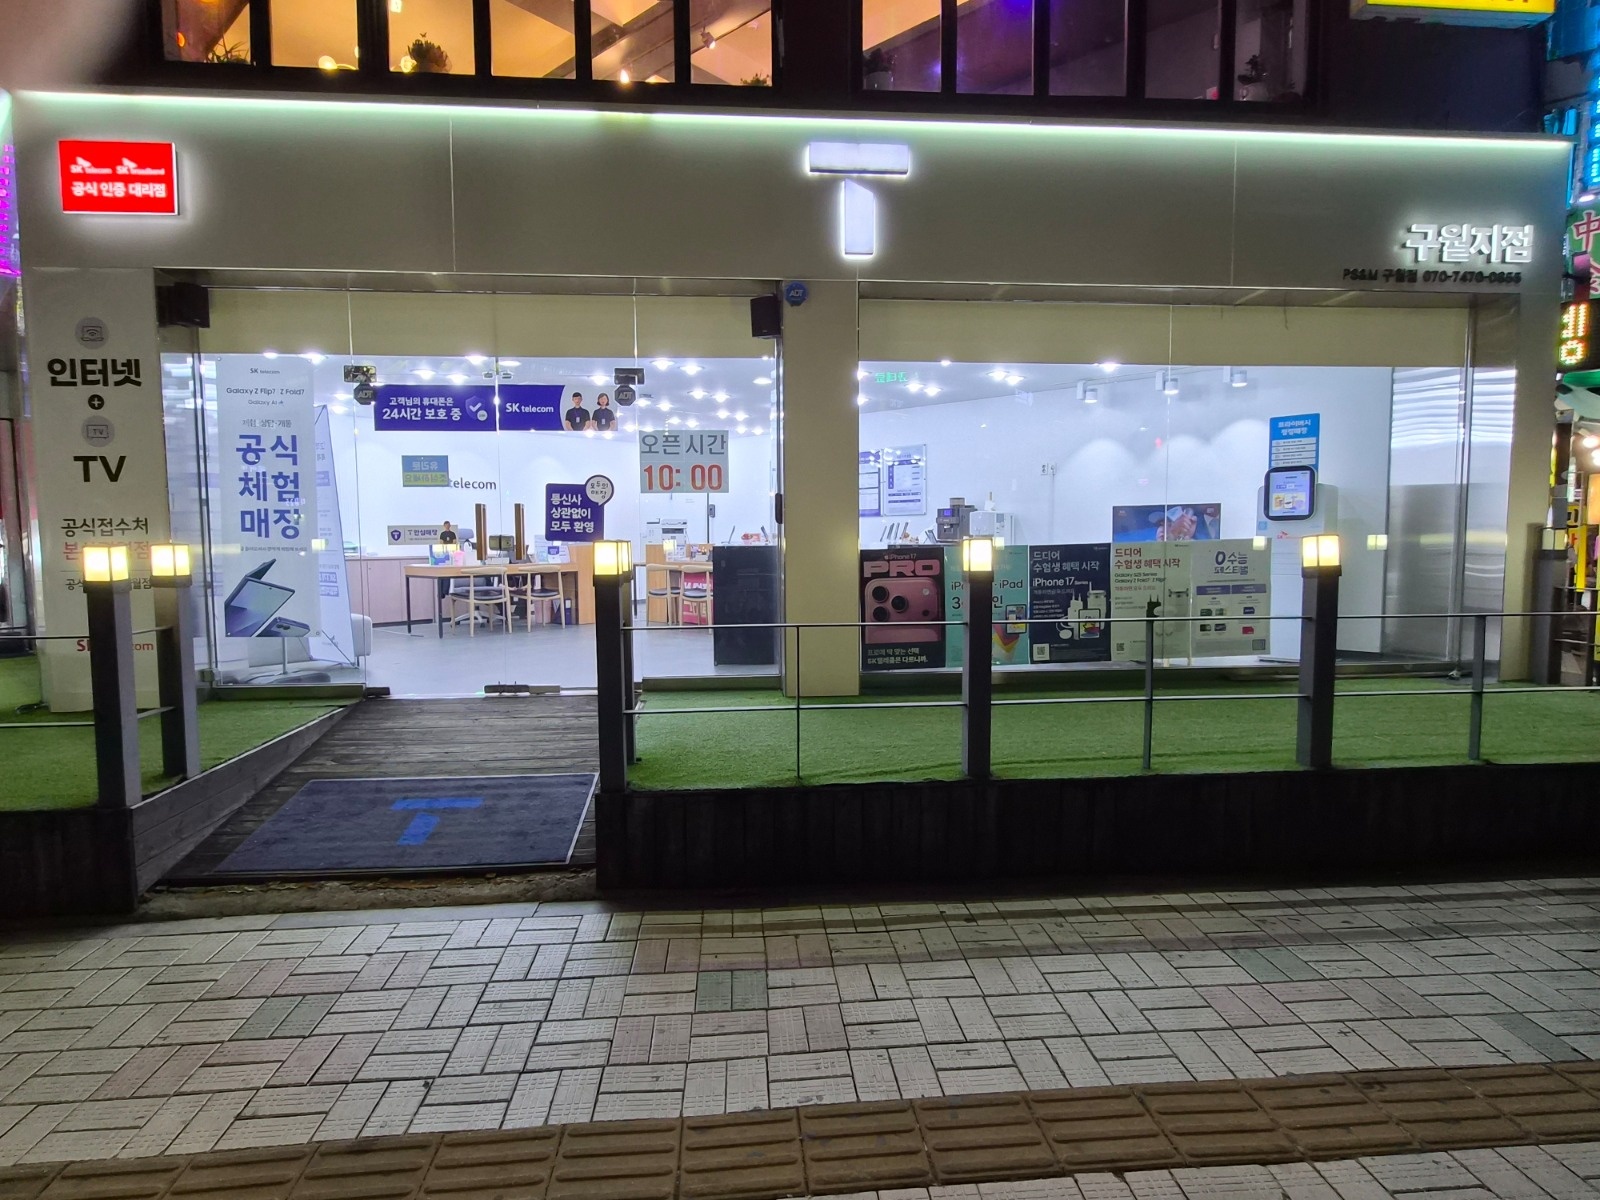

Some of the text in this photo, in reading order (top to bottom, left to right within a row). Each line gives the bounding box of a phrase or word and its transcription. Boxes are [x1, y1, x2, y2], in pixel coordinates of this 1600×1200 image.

[70, 165, 83, 173] SK
[116, 165, 129, 174] SK
[72, 181, 167, 198] 공식 인증 대리점
[1406, 223, 1535, 263] 구월지점
[789, 289, 804, 297] ADT
[47, 358, 142, 387] 인터넷
[226, 387, 253, 396] Galaxy
[286, 388, 305, 396] Fold7
[357, 390, 373, 399] ADT
[617, 390, 633, 400] ADT
[389, 396, 454, 406] 고객님의 휴대폰은
[505, 402, 554, 414] SK telecom
[382, 408, 462, 421] 24시간 보호 중
[235, 434, 298, 466] 공식
[73, 455, 127, 483] TV
[238, 471, 299, 502] 체험
[550, 493, 582, 505] 통신사
[551, 507, 591, 520] 상관없이
[61, 517, 149, 538] 공식접수처
[240, 508, 300, 539] 매장
[550, 521, 594, 533] 모두 환영
[1033, 550, 1060, 561] 드디어
[1115, 547, 1142, 558] 드디어
[863, 559, 940, 577] PRO
[1033, 561, 1099, 573] 수험생 혜택 시작
[1115, 558, 1180, 570] 수험생 혜택 시작
[999, 579, 1023, 589] iPad
[1033, 577, 1064, 587] iPhone
[1066, 576, 1075, 586] 17
